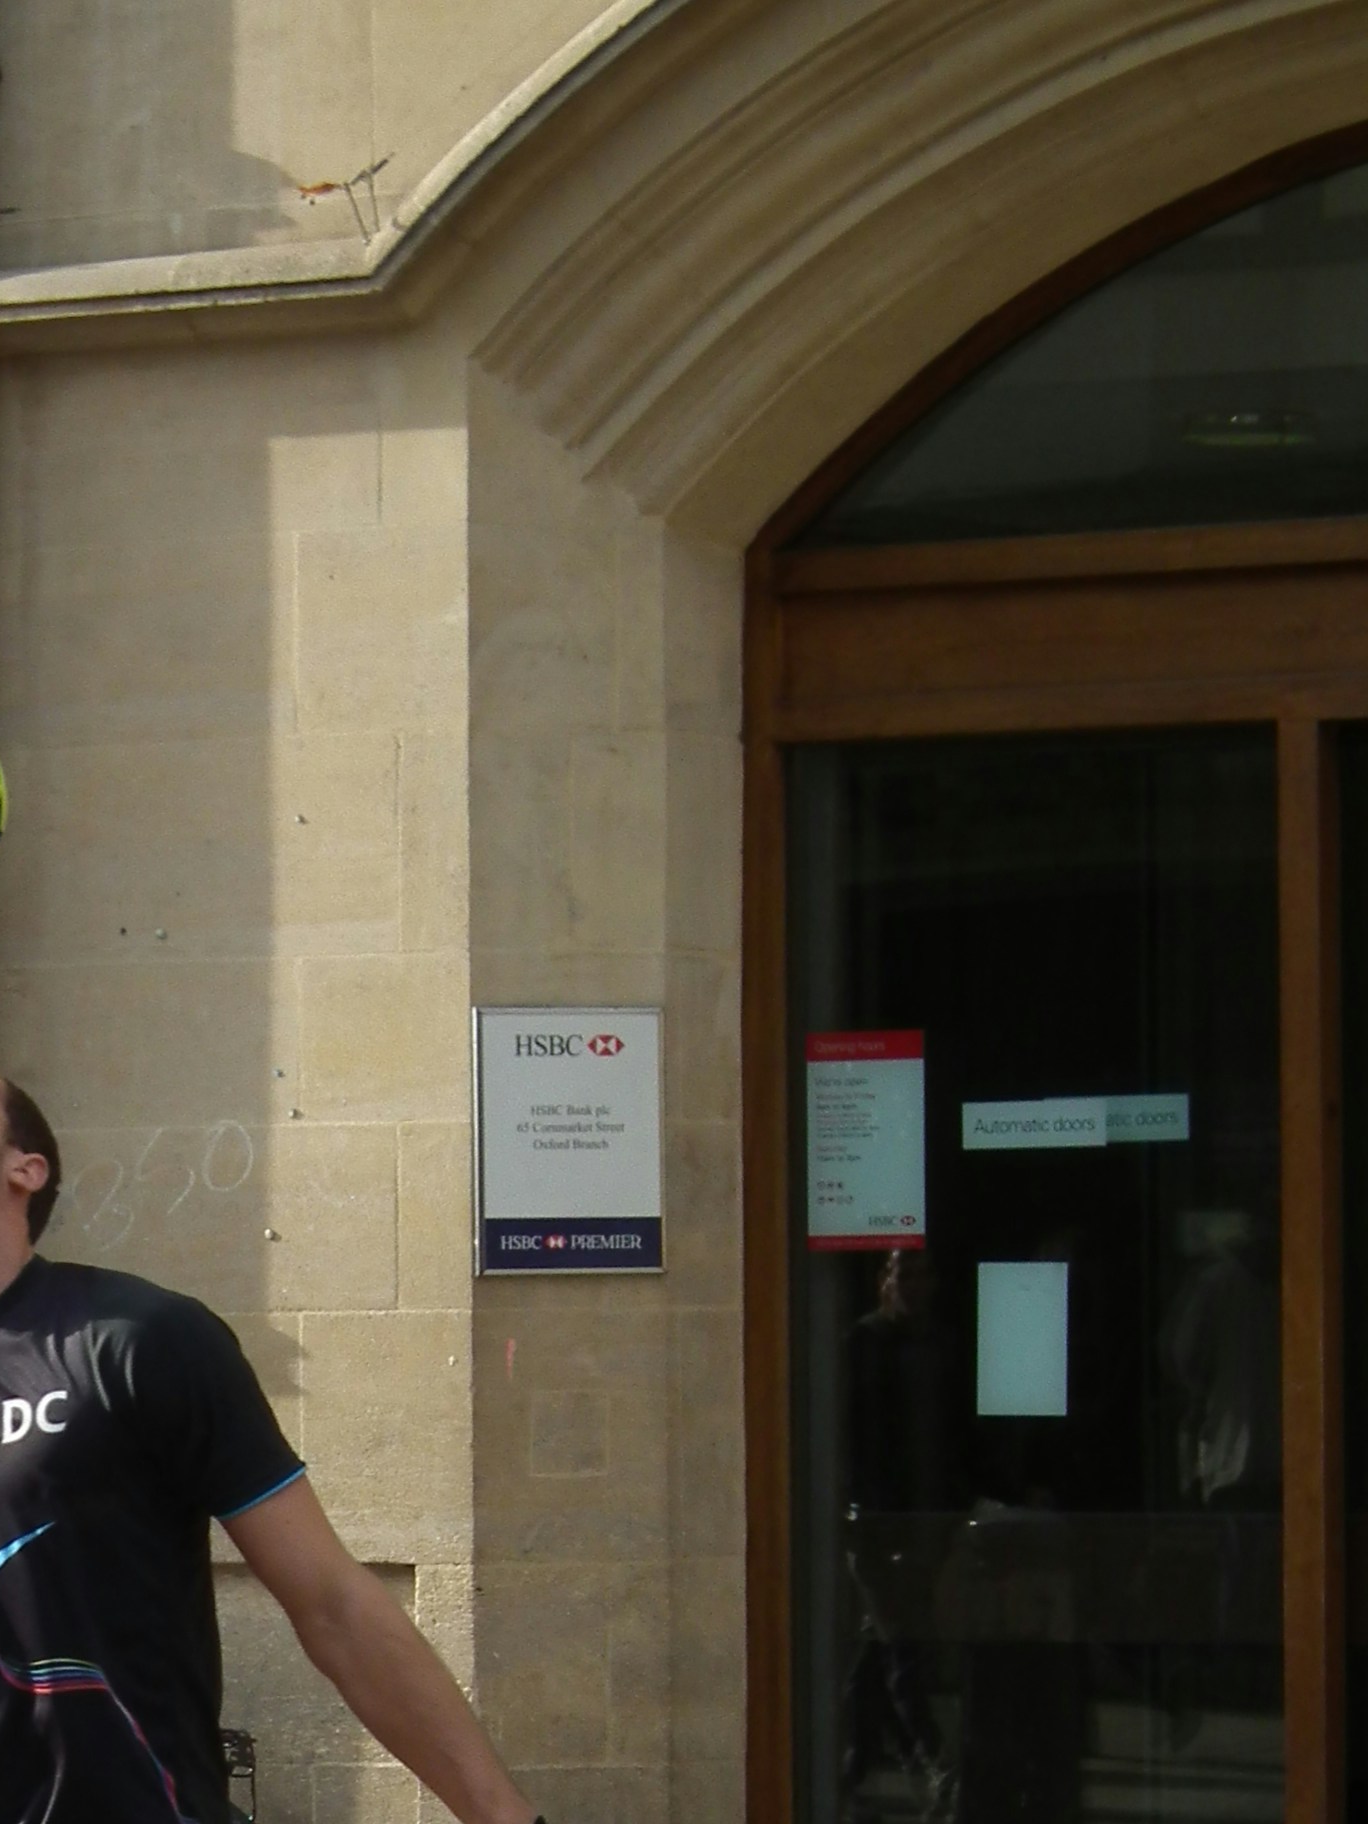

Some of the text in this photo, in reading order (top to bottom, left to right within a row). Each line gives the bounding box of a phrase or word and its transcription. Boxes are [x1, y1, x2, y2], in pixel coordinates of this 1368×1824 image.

[515, 1034, 583, 1057] HSBC
[531, 1104, 611, 1118] HSBC Bank plc
[1134, 1110, 1179, 1126] doors
[516, 1121, 530, 1133] 65
[595, 1121, 625, 1133] Street
[973, 1118, 1049, 1134] Automatic
[1052, 1116, 1096, 1132] doors
[532, 1138, 609, 1150] Oxford Branch
[500, 1234, 642, 1250] HSBC PREMIER
[0, 1389, 70, 1445] DC
